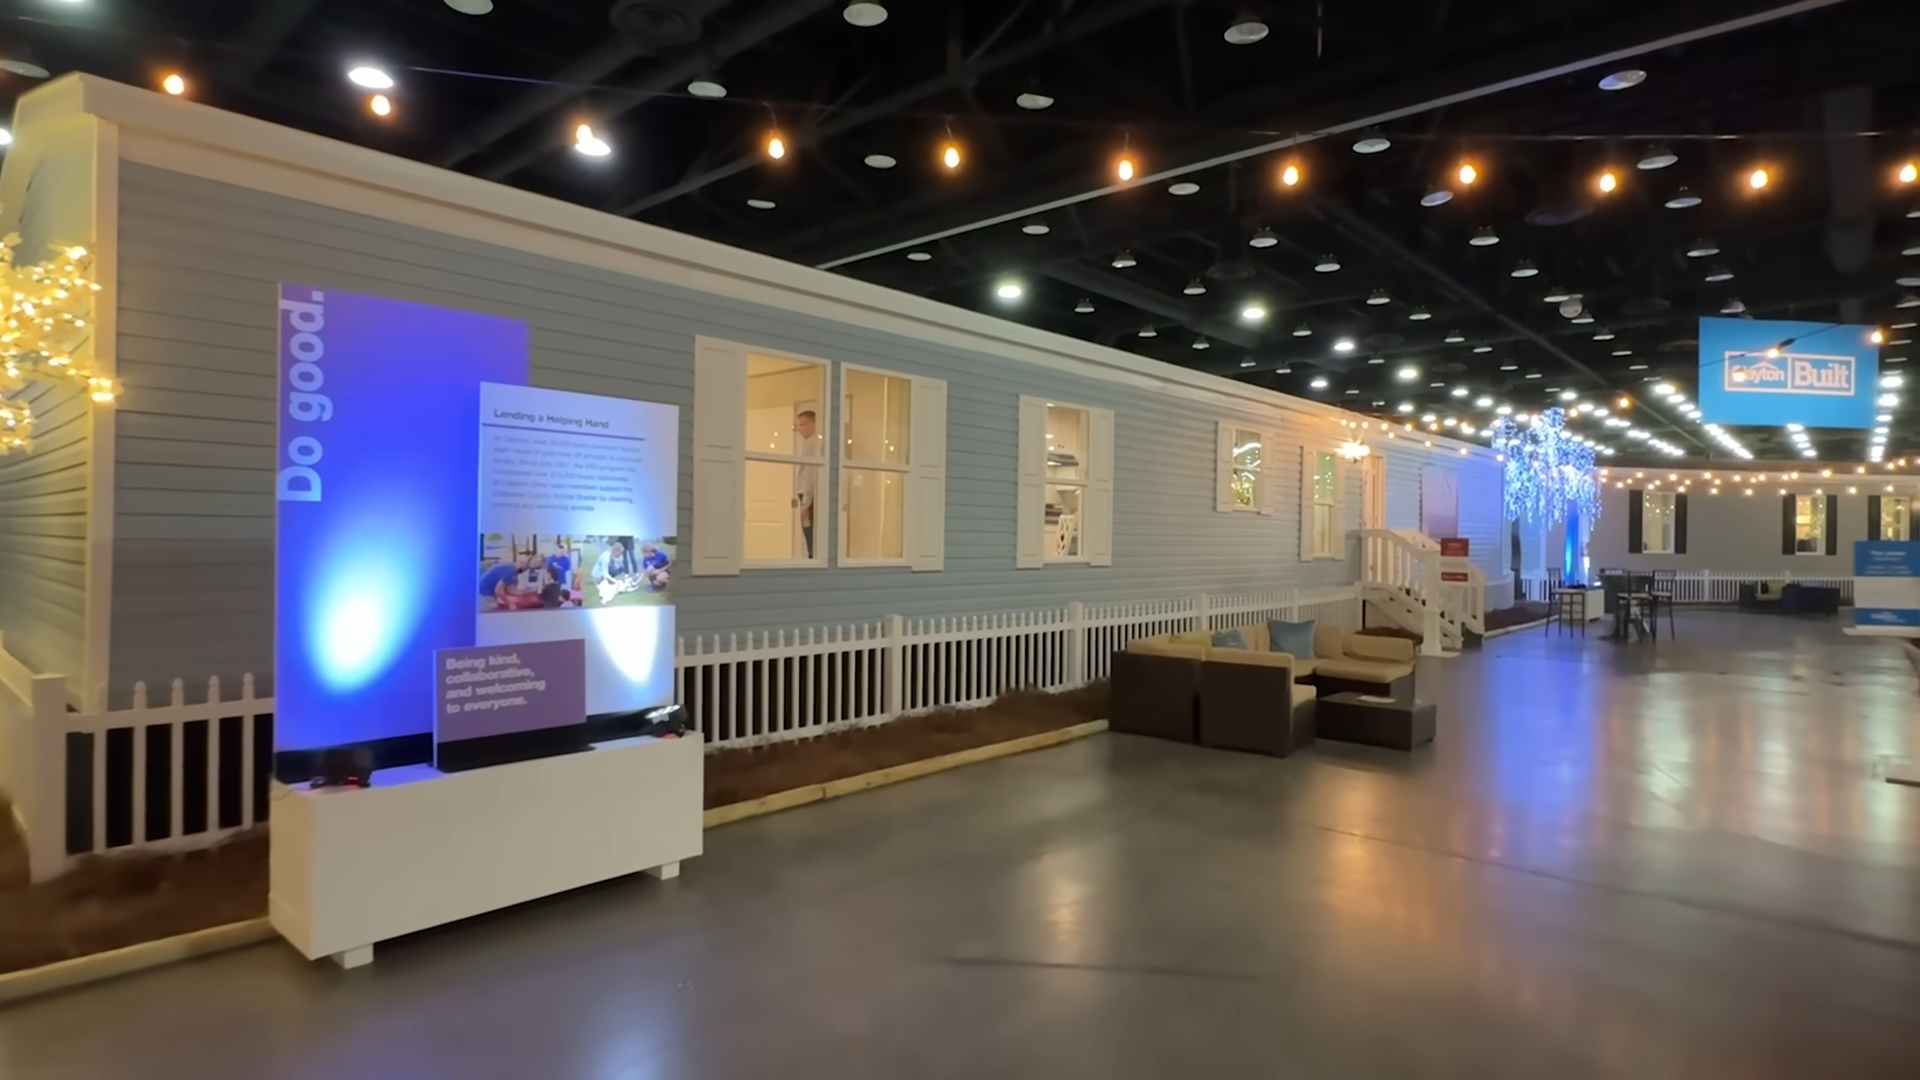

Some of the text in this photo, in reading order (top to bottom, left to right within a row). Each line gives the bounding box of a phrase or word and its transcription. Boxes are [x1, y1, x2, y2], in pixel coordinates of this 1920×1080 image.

[1794, 361, 1849, 388] Built
[276, 290, 333, 502] Do good.
[494, 408, 609, 429] Lending a Helping Hand
[446, 653, 521, 670] Being kind,
[445, 667, 535, 685] collaborative,
[445, 679, 546, 699] and welcoming
[446, 695, 529, 714] to everyone.
